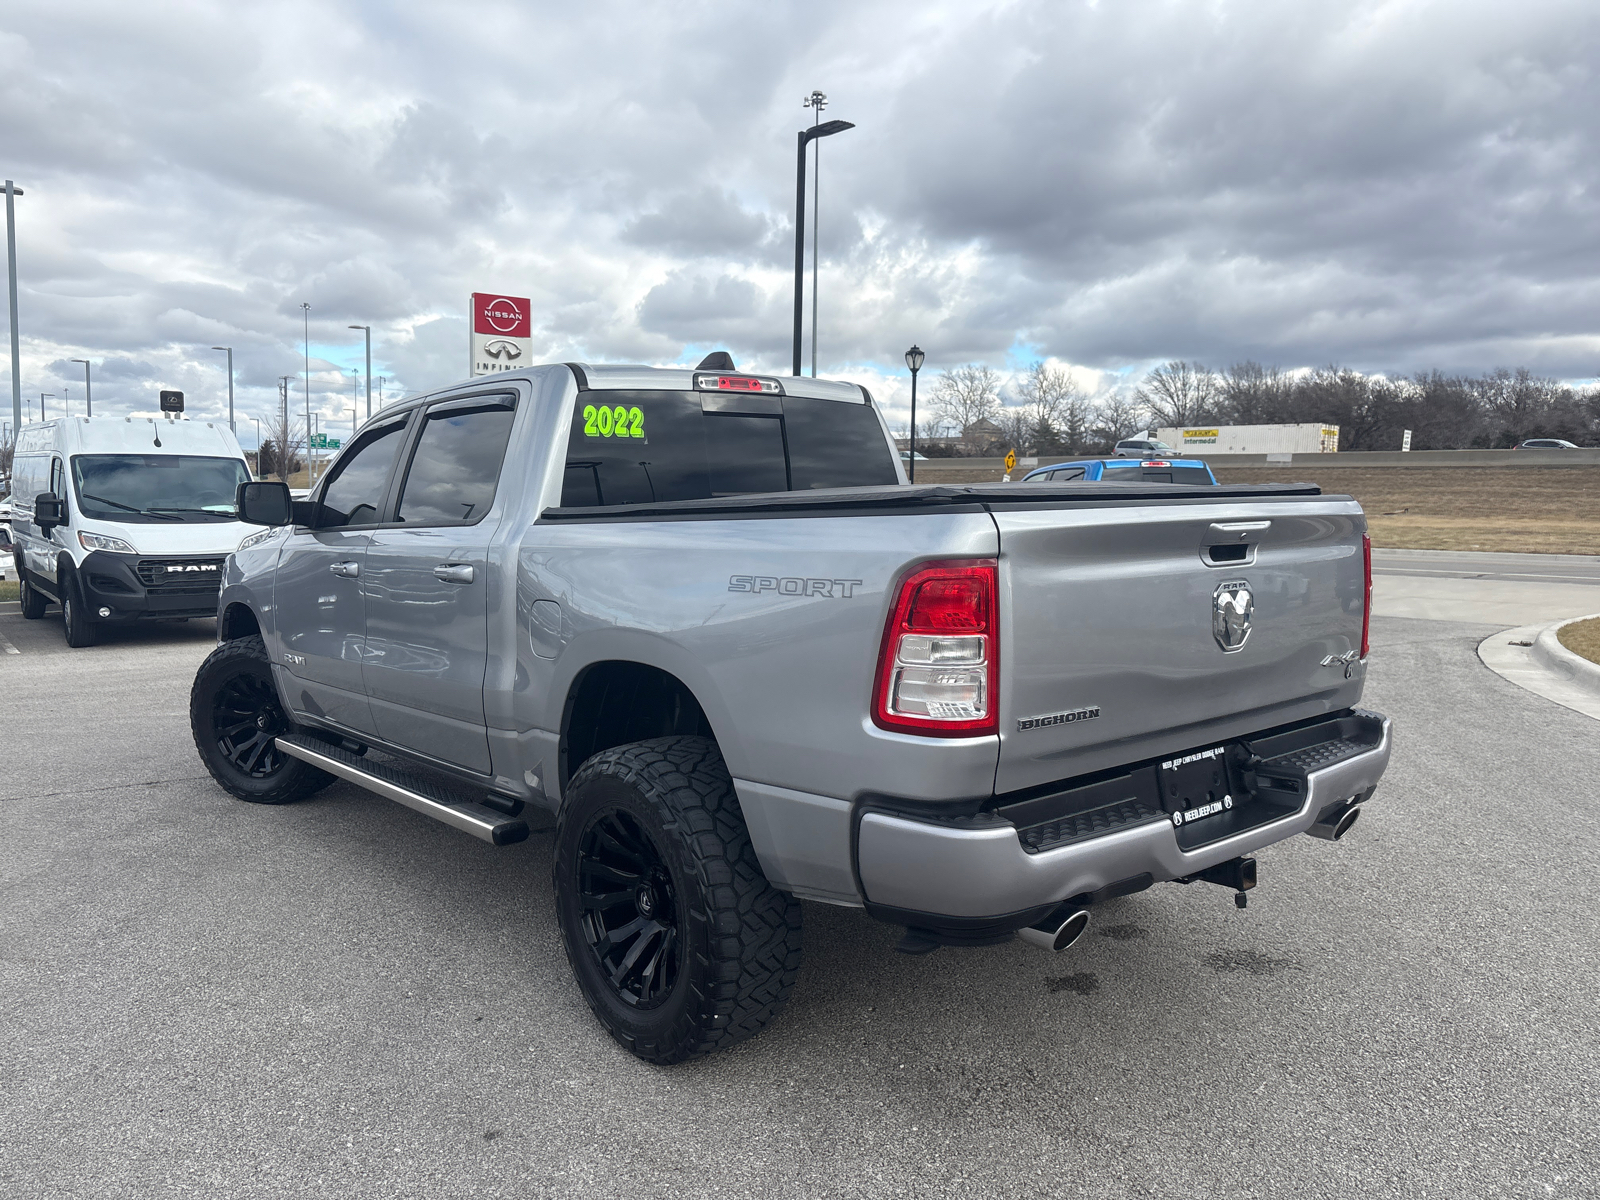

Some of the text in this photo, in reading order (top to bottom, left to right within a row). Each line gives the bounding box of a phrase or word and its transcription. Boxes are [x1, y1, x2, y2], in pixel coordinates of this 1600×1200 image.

[484, 310, 522, 320] NISSAN
[476, 362, 524, 371] INFINI
[583, 404, 645, 438] 2022
[728, 574, 863, 599] SPORT
[1018, 706, 1101, 732] BIGHORN
[1162, 747, 1224, 770] REED JEEP CHRYSLER DODGE RAM
[1184, 801, 1223, 822] REEDJEEP.COM
